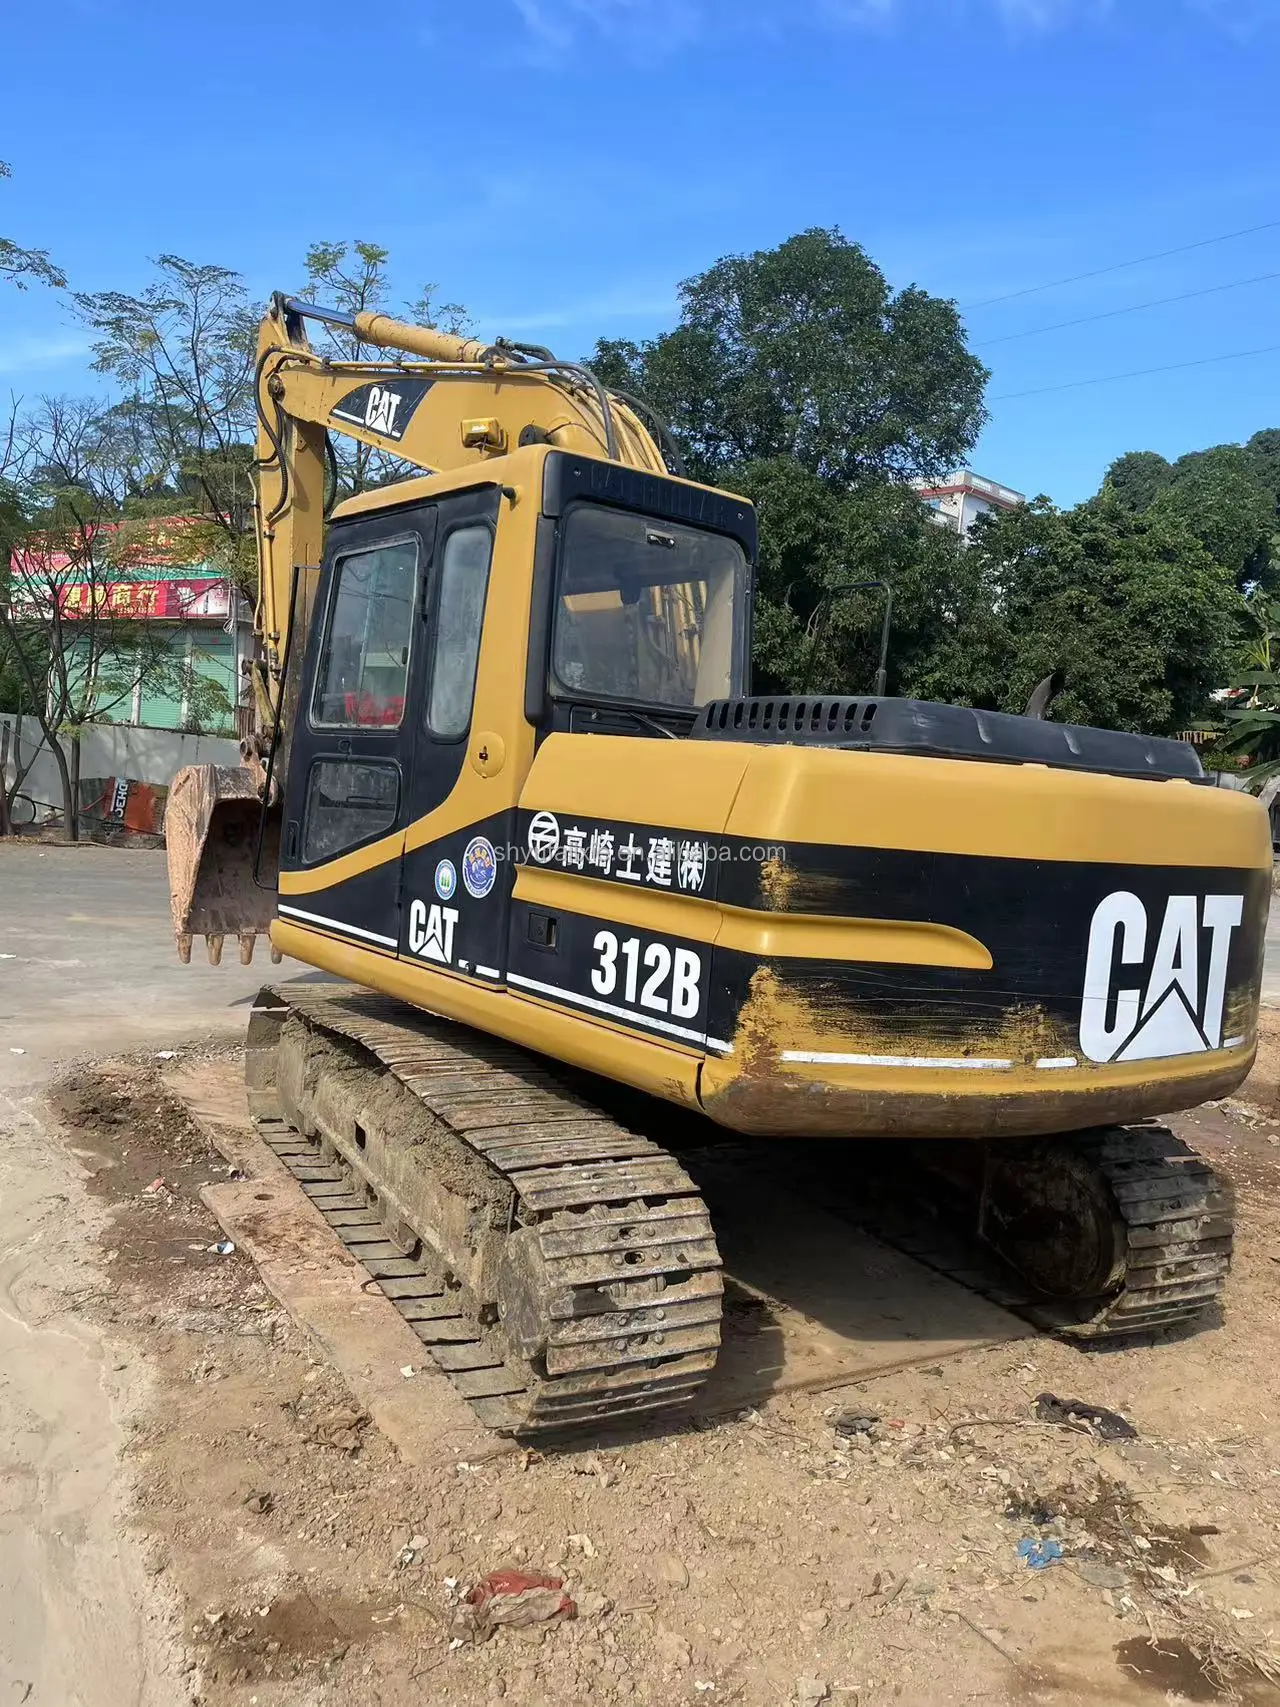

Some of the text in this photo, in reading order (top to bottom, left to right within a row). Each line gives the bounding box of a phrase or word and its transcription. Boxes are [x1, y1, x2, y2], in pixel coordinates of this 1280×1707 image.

[365, 386, 402, 435] CAT
[409, 899, 460, 964] CAT
[591, 930, 702, 1020] 312B
[1080, 891, 1244, 1062] CAT
